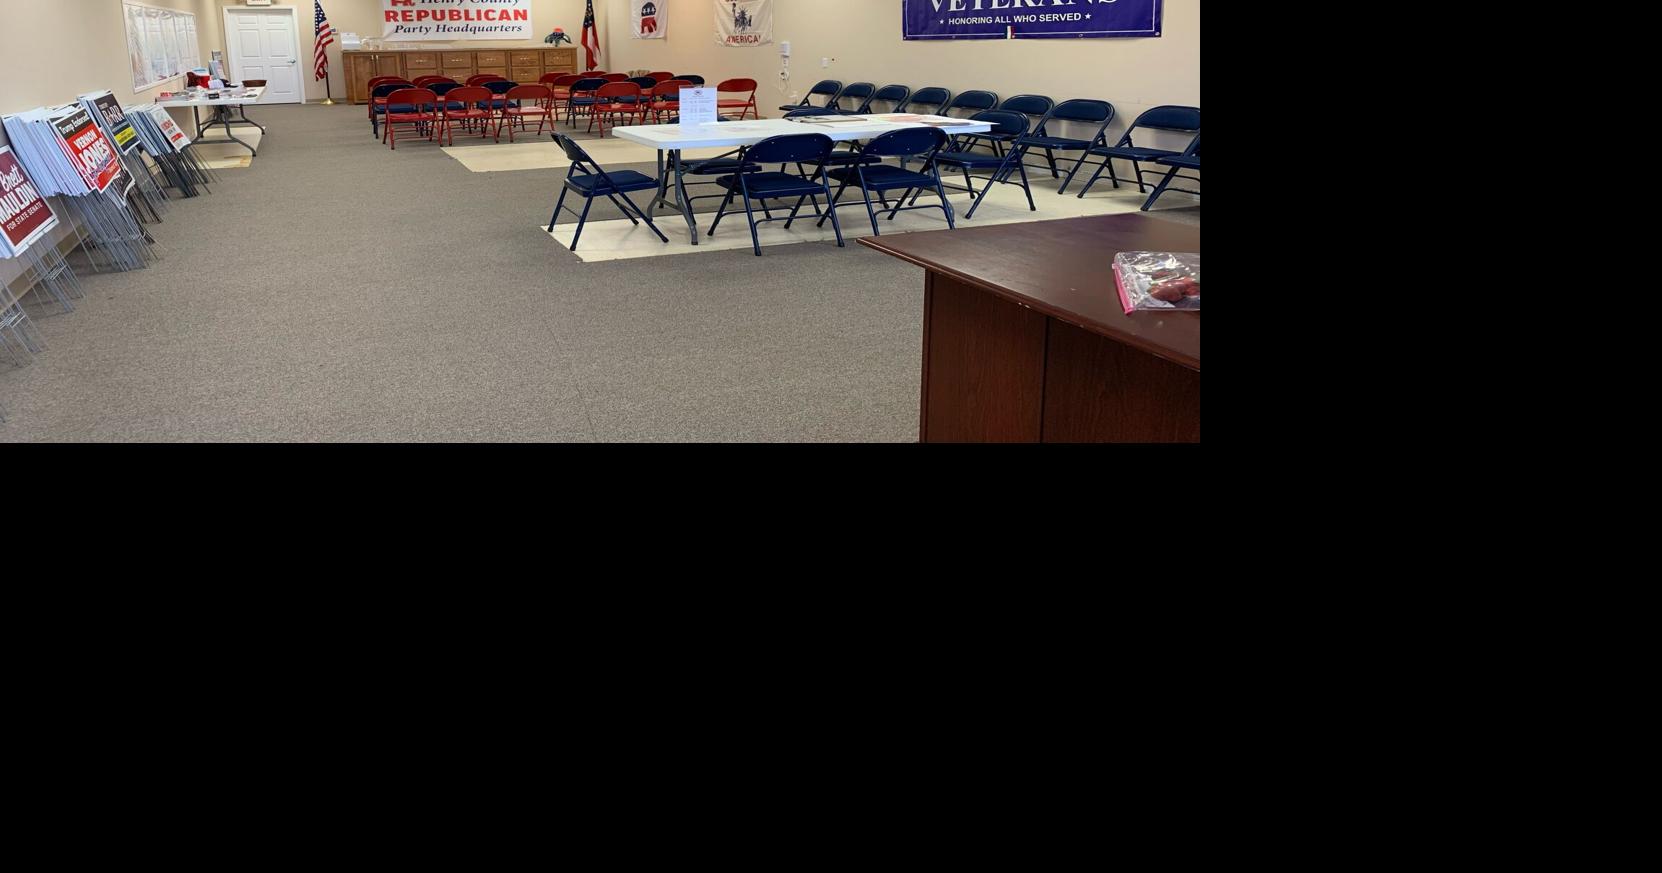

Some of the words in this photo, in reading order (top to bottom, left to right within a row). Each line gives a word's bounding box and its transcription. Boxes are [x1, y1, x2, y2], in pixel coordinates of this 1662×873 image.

[384, 8, 528, 23] REPUBLICAN
[948, 16, 993, 25] HONORING
[994, 15, 1012, 24] ALL
[1013, 14, 1037, 23] WHO
[1039, 12, 1081, 22] SERVED
[394, 24, 432, 35] Party
[435, 23, 522, 35] Headquarters
[73, 129, 98, 150] VERNON
[78, 137, 111, 174] JONES
[6, 218, 17, 232] FOR
[16, 211, 29, 225] STATE
[27, 201, 43, 217] SENATE
